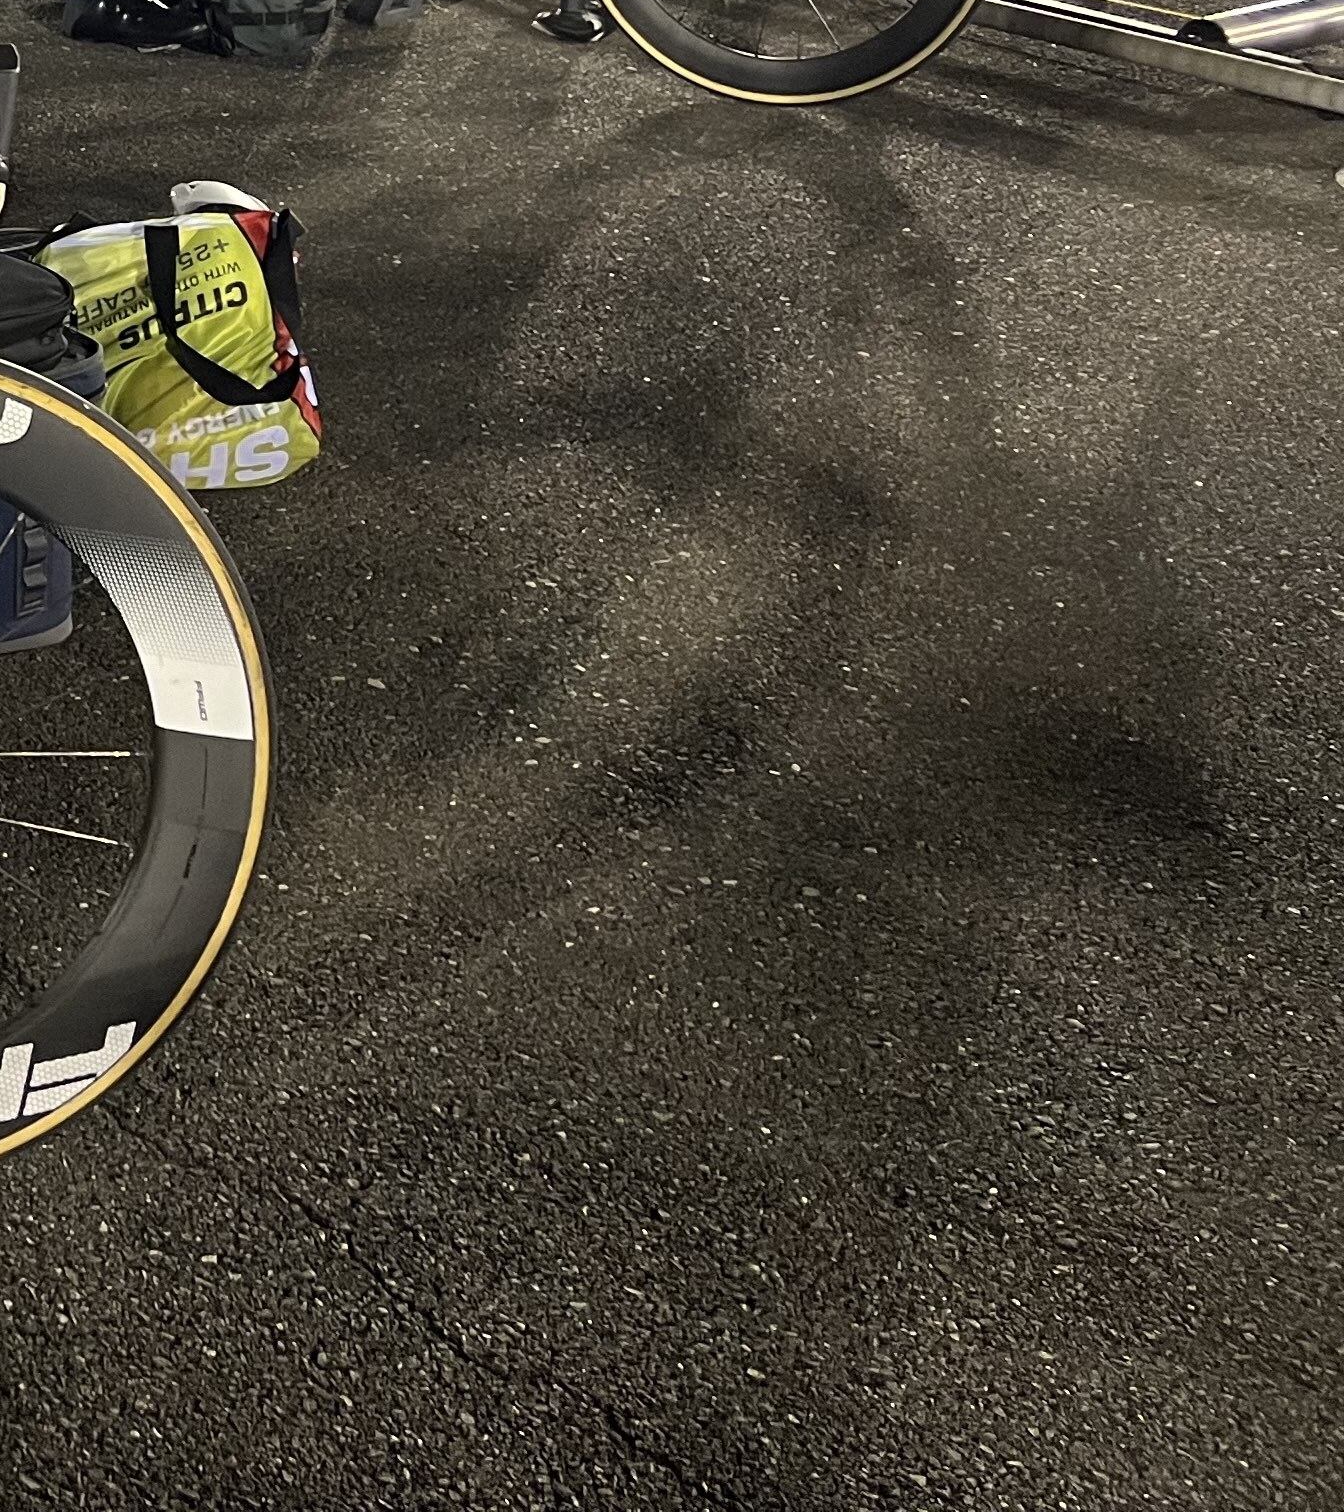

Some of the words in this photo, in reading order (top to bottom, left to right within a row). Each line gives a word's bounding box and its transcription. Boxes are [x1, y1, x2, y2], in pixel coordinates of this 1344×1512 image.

[203, 261, 241, 283] WITH
[78, 286, 137, 324] CAFF
[135, 426, 157, 449] G
[169, 425, 289, 488] SH
